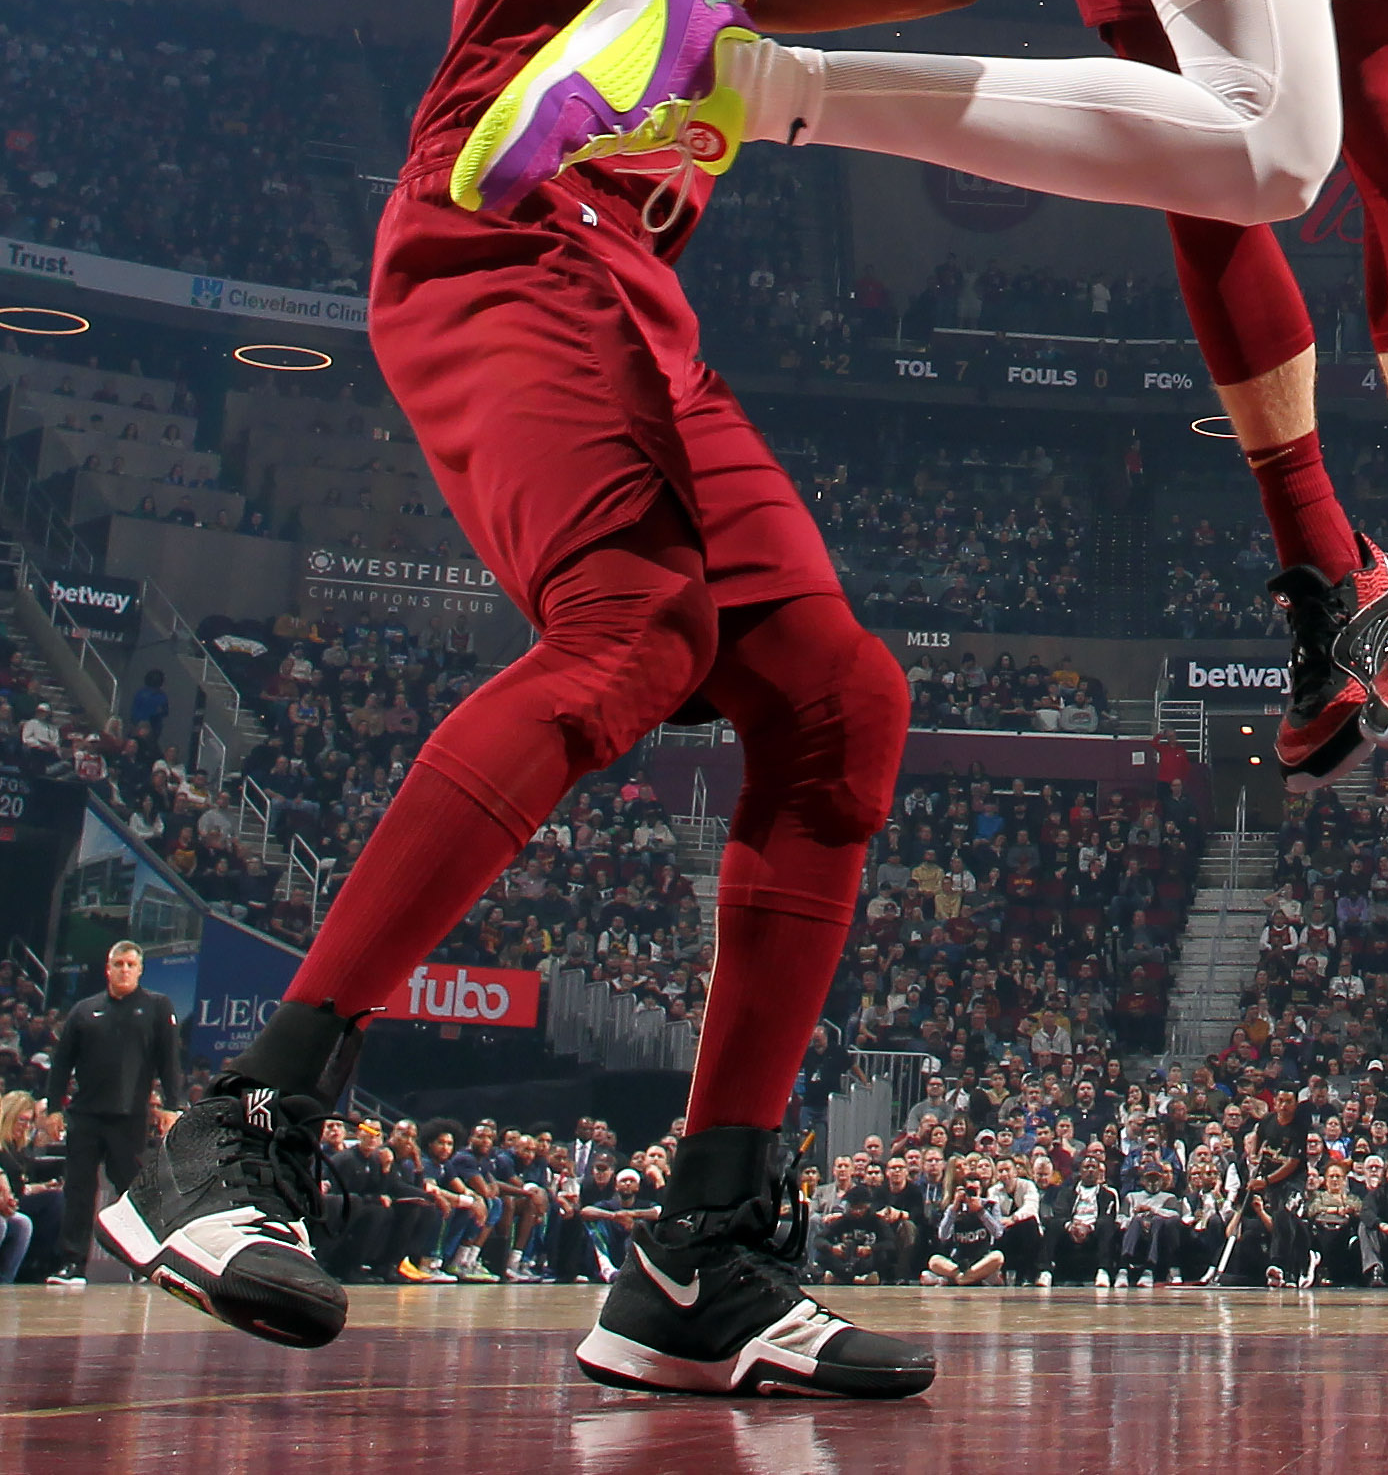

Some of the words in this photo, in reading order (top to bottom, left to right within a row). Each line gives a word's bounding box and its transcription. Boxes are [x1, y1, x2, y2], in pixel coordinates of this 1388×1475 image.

[8, 242, 74, 275] Trust.
[229, 288, 321, 318] Cleveland
[895, 359, 938, 379] TOL
[955, 361, 968, 381] 7
[1007, 365, 1077, 387] FOULS
[1143, 371, 1193, 390] FG%
[341, 556, 496, 587] WESTFIELD
[51, 580, 130, 614] betway
[308, 586, 431, 608] CHAMPIONS
[443, 598, 494, 613] CLUB
[907, 631, 951, 647] M113
[408, 965, 510, 1020] fubo
